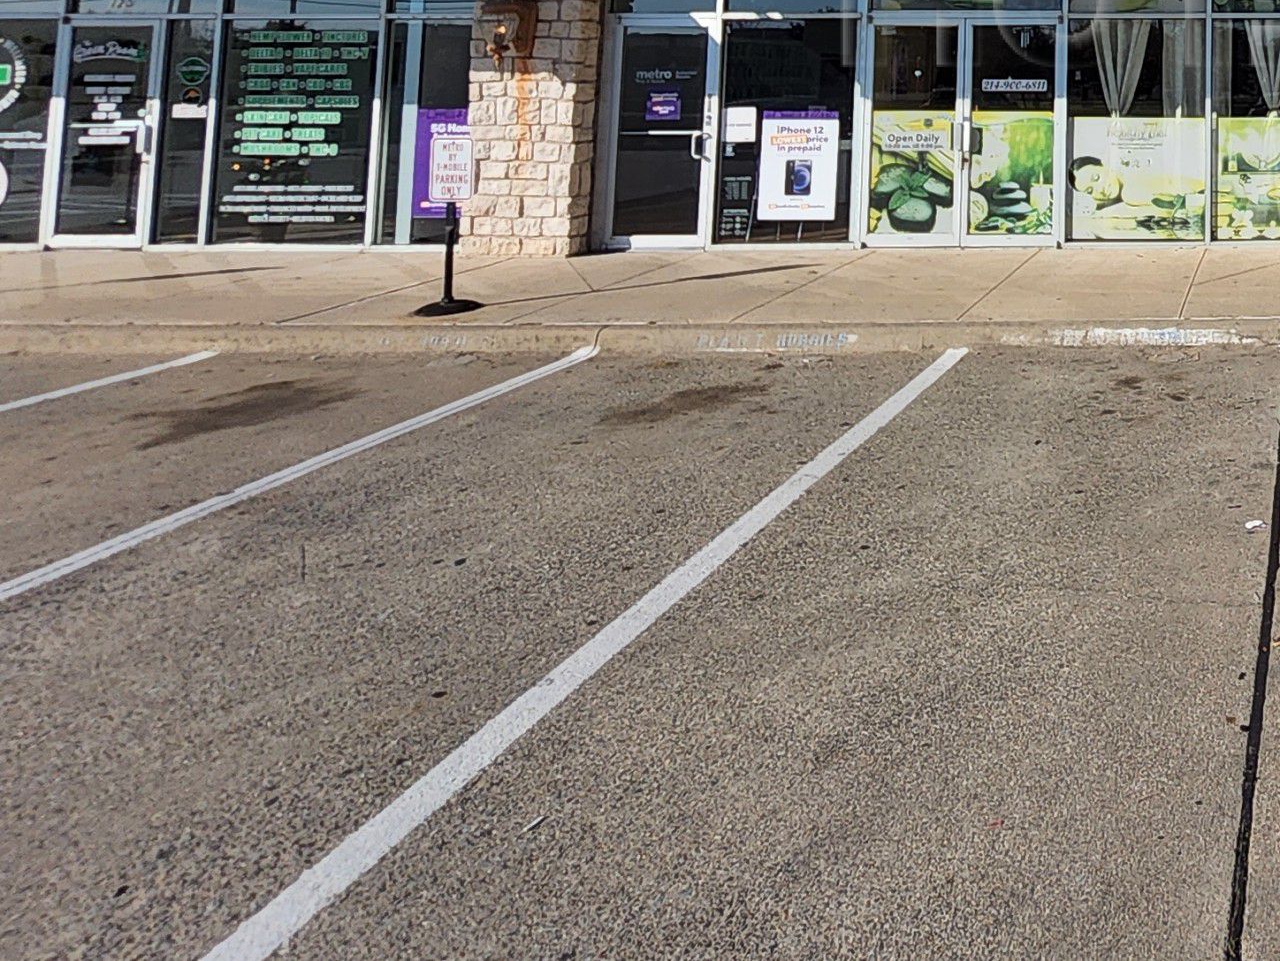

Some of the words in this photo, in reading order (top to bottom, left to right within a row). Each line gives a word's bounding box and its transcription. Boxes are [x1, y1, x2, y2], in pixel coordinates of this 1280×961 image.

[636, 68, 672, 79] metro
[777, 126, 811, 134] iPhone
[814, 126, 824, 134] 12
[807, 136, 829, 145] price
[887, 133, 914, 143] Open
[915, 133, 940, 143] Daily
[788, 145, 822, 153] prepaid
[436, 175, 468, 184] PARKING
[441, 187, 461, 196] ONLY
